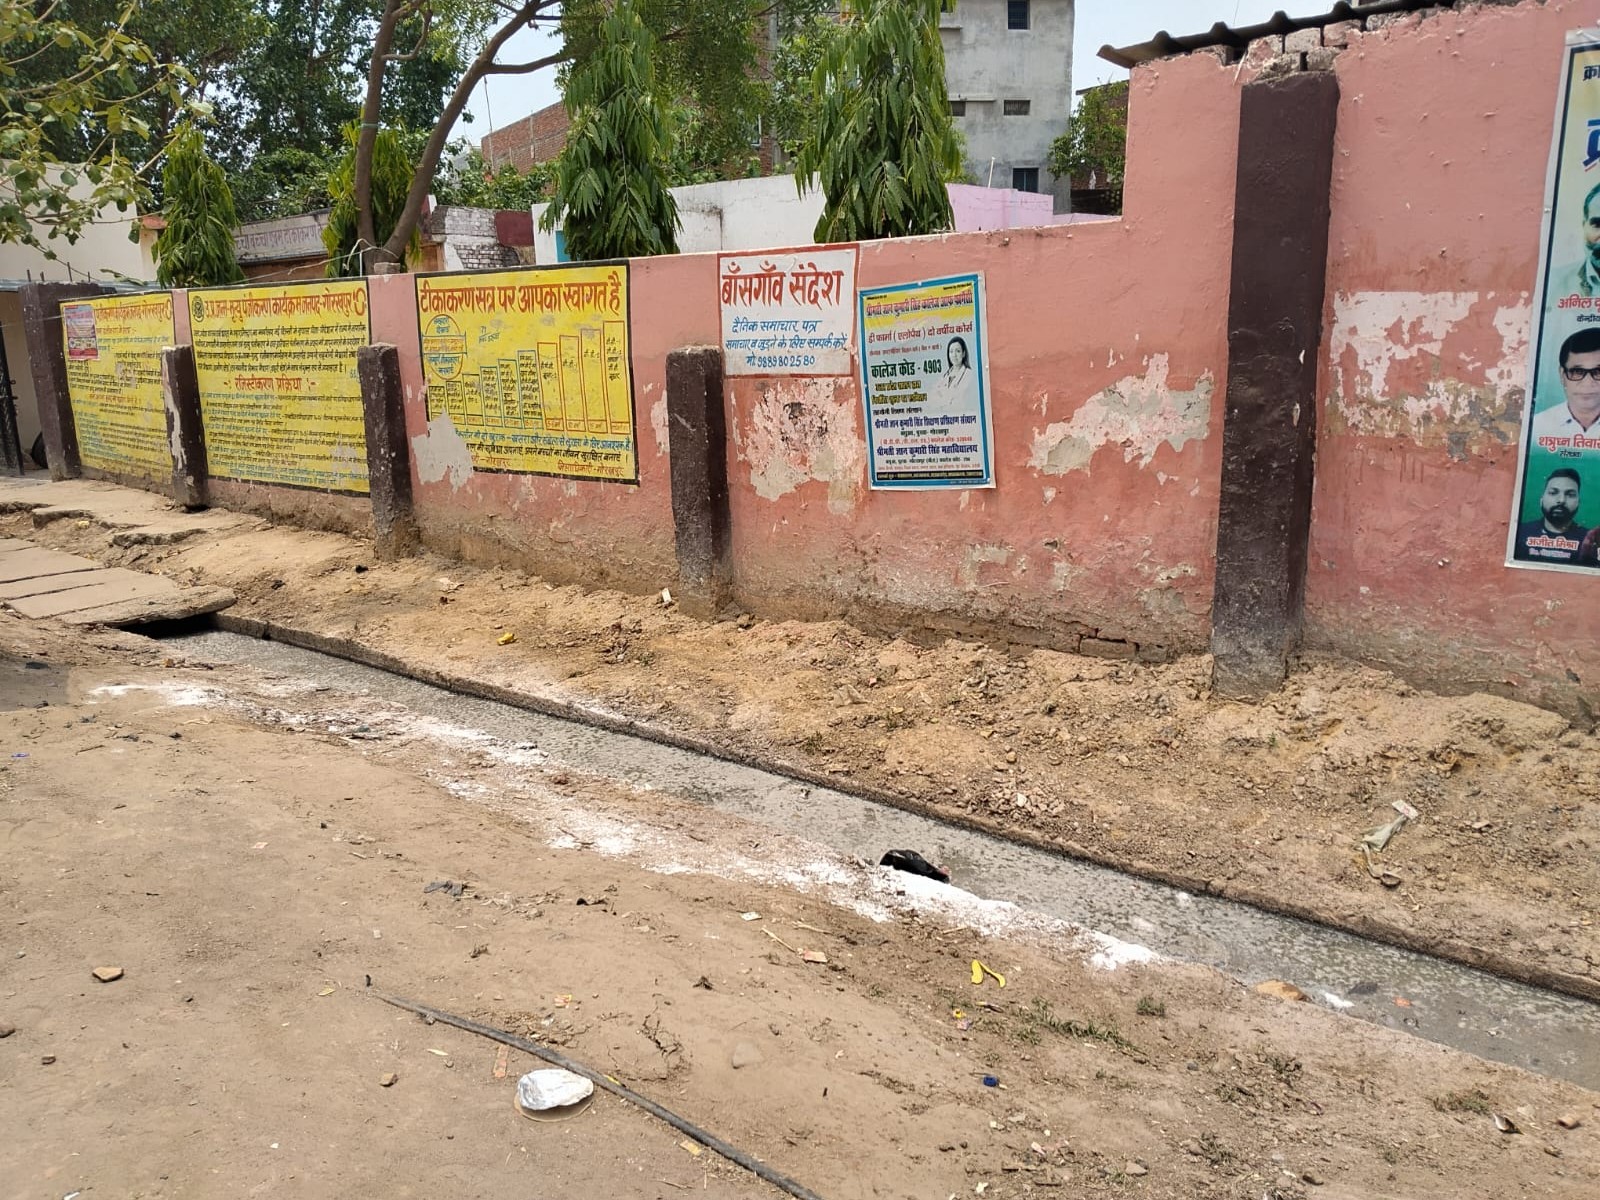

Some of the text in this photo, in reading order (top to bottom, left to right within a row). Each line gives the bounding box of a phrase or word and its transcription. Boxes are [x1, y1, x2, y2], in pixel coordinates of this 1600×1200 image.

[420, 271, 621, 316] टीकाकरण सत्र पर आपका स्वागत है
[722, 260, 845, 310] बाँसगाँव संदेश
[1558, 293, 1592, 309] अनिल
[759, 319, 799, 332] समाचार
[802, 319, 823, 333] पत्र
[875, 329, 892, 342] फार्मा
[927, 325, 935, 336] दो
[936, 322, 955, 335] वर्षीय
[955, 320, 973, 333] कोर्स
[726, 339, 751, 350] समाचार
[777, 334, 787, 348] के
[789, 333, 807, 348] लिए
[807, 332, 833, 349] सम्पर्क
[871, 360, 897, 378] कालेज
[897, 358, 915, 376] कोड
[923, 358, 942, 375] 4903
[275, 373, 302, 393] प्रक्रिया
[875, 418, 889, 428] श्रीमती
[899, 417, 914, 430] कुमारी
[959, 413, 977, 425] संस्थान
[877, 443, 978, 458] श्रीमती ज्ञान कुमारी सिंह महाविद्यालय
[1538, 436, 1571, 452] शत्रुघ्न
[580, 449, 602, 463] सुरक्षित
[1527, 535, 1578, 550] अजीत मिश्रा
